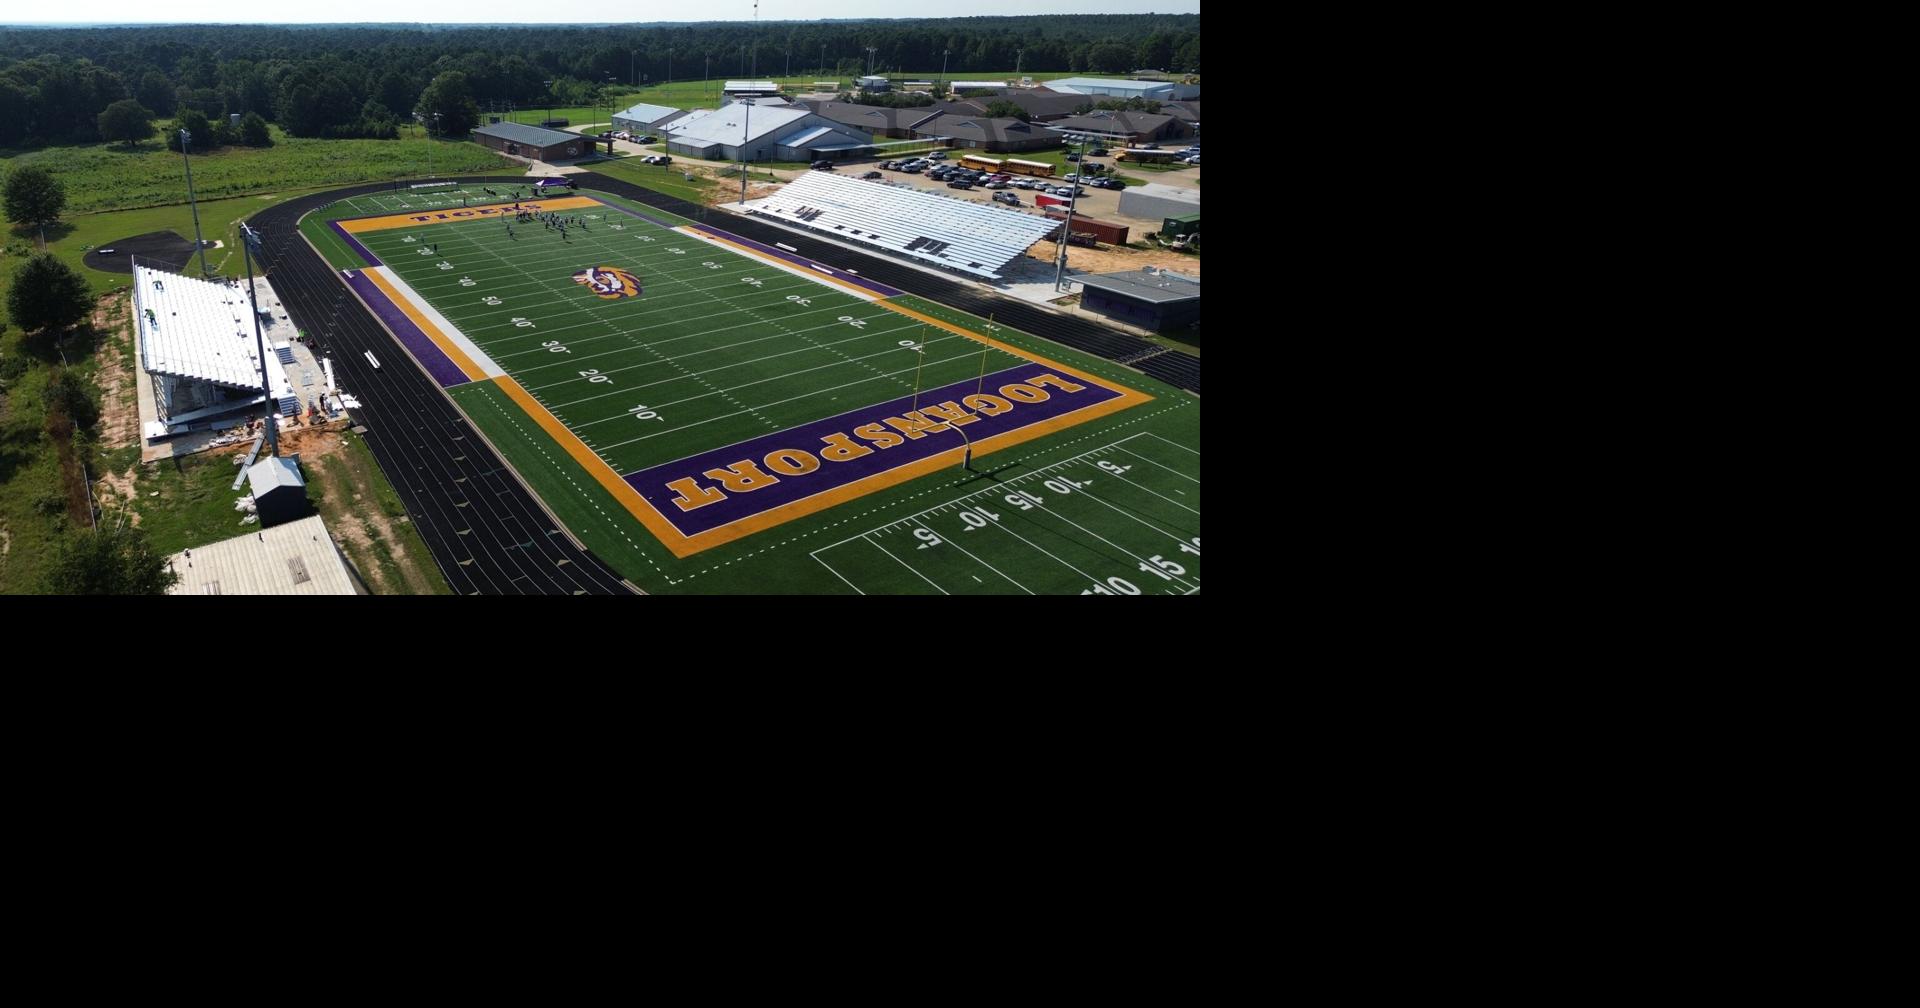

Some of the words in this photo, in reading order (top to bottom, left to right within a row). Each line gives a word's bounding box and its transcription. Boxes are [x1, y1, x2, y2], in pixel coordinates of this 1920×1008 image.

[741, 277, 763, 288] 40
[482, 296, 502, 306] 50
[786, 295, 811, 307] 30
[511, 317, 532, 328] 40
[837, 315, 867, 329] 20
[541, 340, 567, 353] 30
[578, 368, 608, 384] 20
[628, 404, 657, 420] 10
[665, 373, 1086, 512] LOGANSPORT
[1097, 460, 1126, 475] 5
[1043, 476, 1082, 494] 10
[1004, 490, 1043, 511] 15
[959, 506, 1000, 528] 10
[912, 528, 943, 547] 5
[1139, 554, 1186, 580] 15
